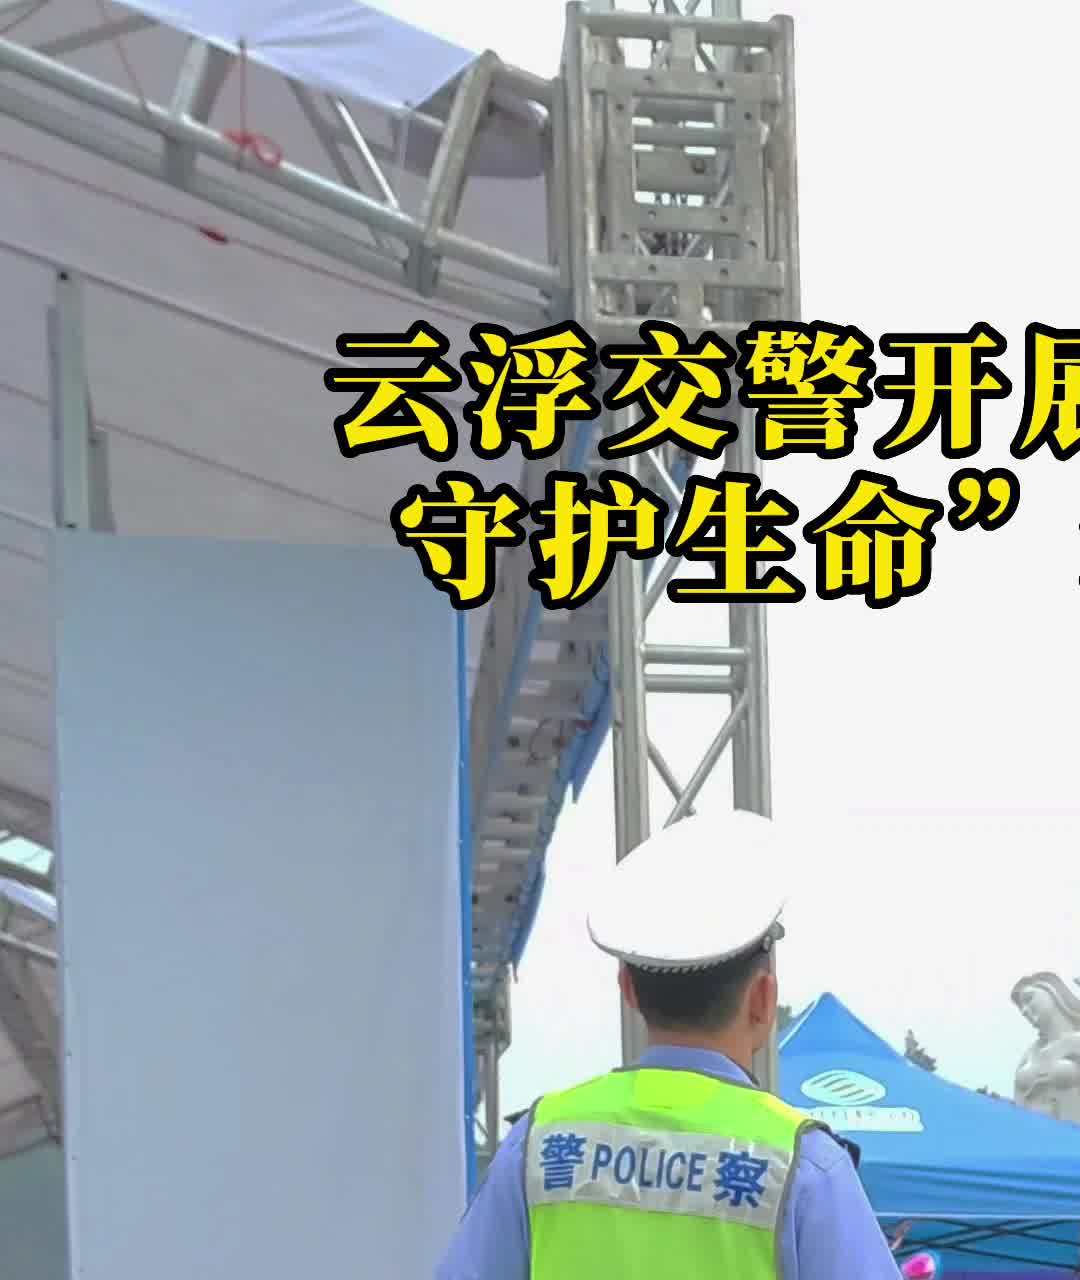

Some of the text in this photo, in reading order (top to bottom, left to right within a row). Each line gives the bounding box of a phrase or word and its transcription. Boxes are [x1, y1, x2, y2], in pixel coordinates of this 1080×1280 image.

[540, 1133, 769, 1208] 警 POLICE 察
